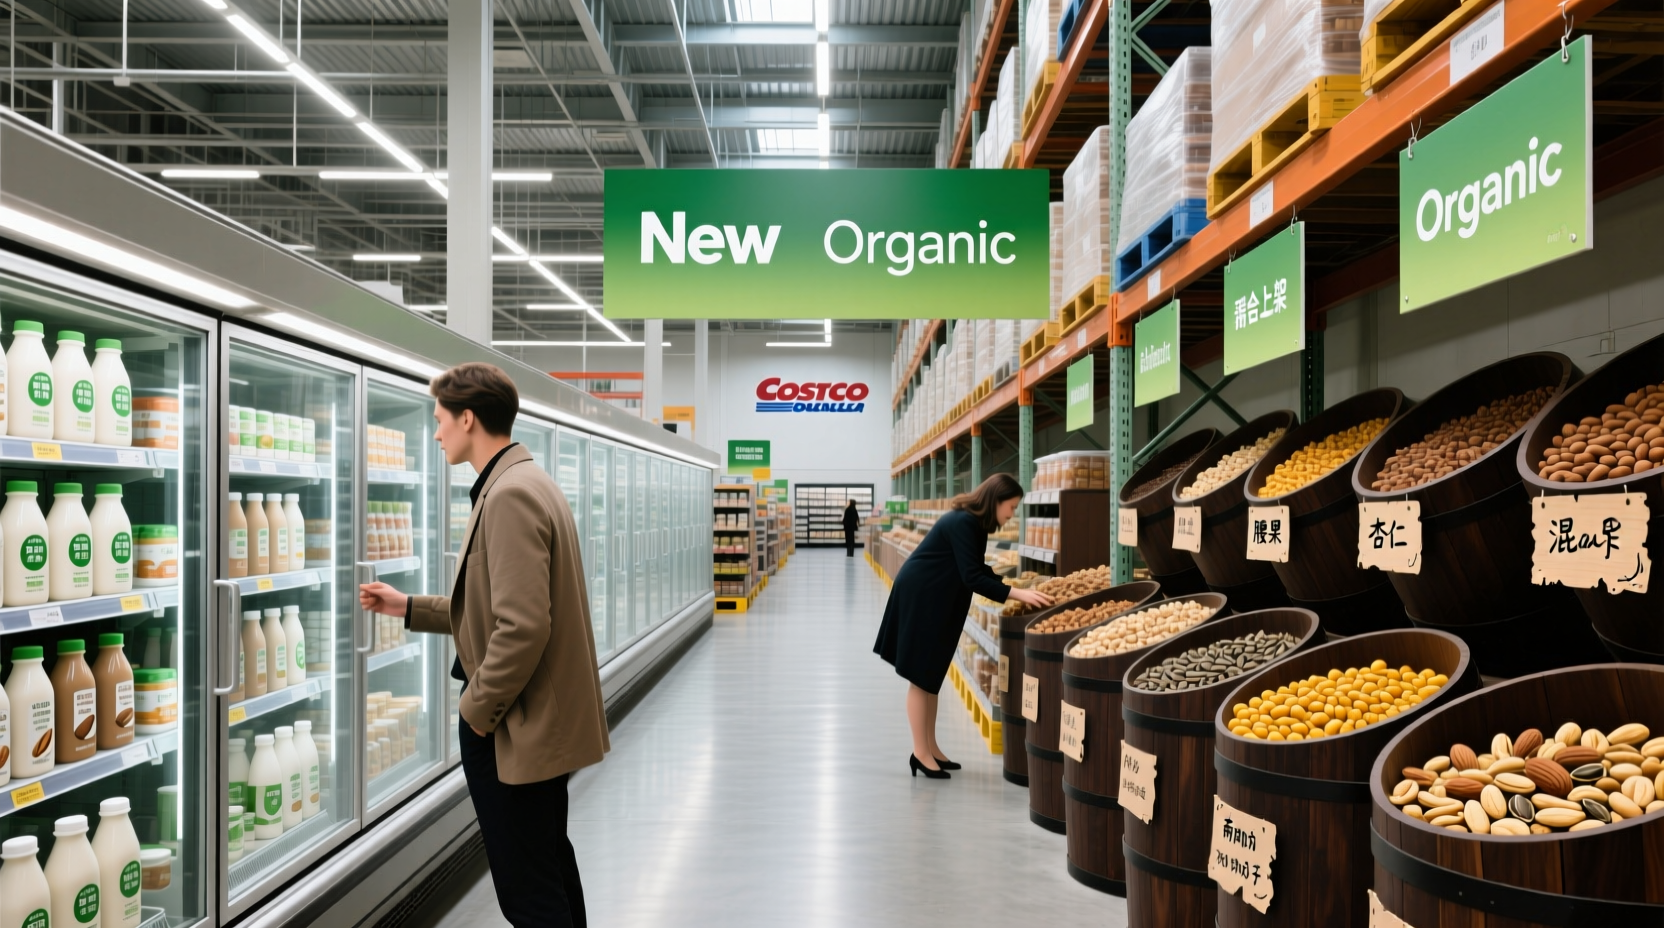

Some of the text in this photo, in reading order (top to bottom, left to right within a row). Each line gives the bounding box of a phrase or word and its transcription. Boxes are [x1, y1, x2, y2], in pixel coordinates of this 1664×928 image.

[1416, 136, 1562, 242] Organic
[640, 211, 1016, 276] New Organic
[1368, 517, 1408, 549] 杏仁
